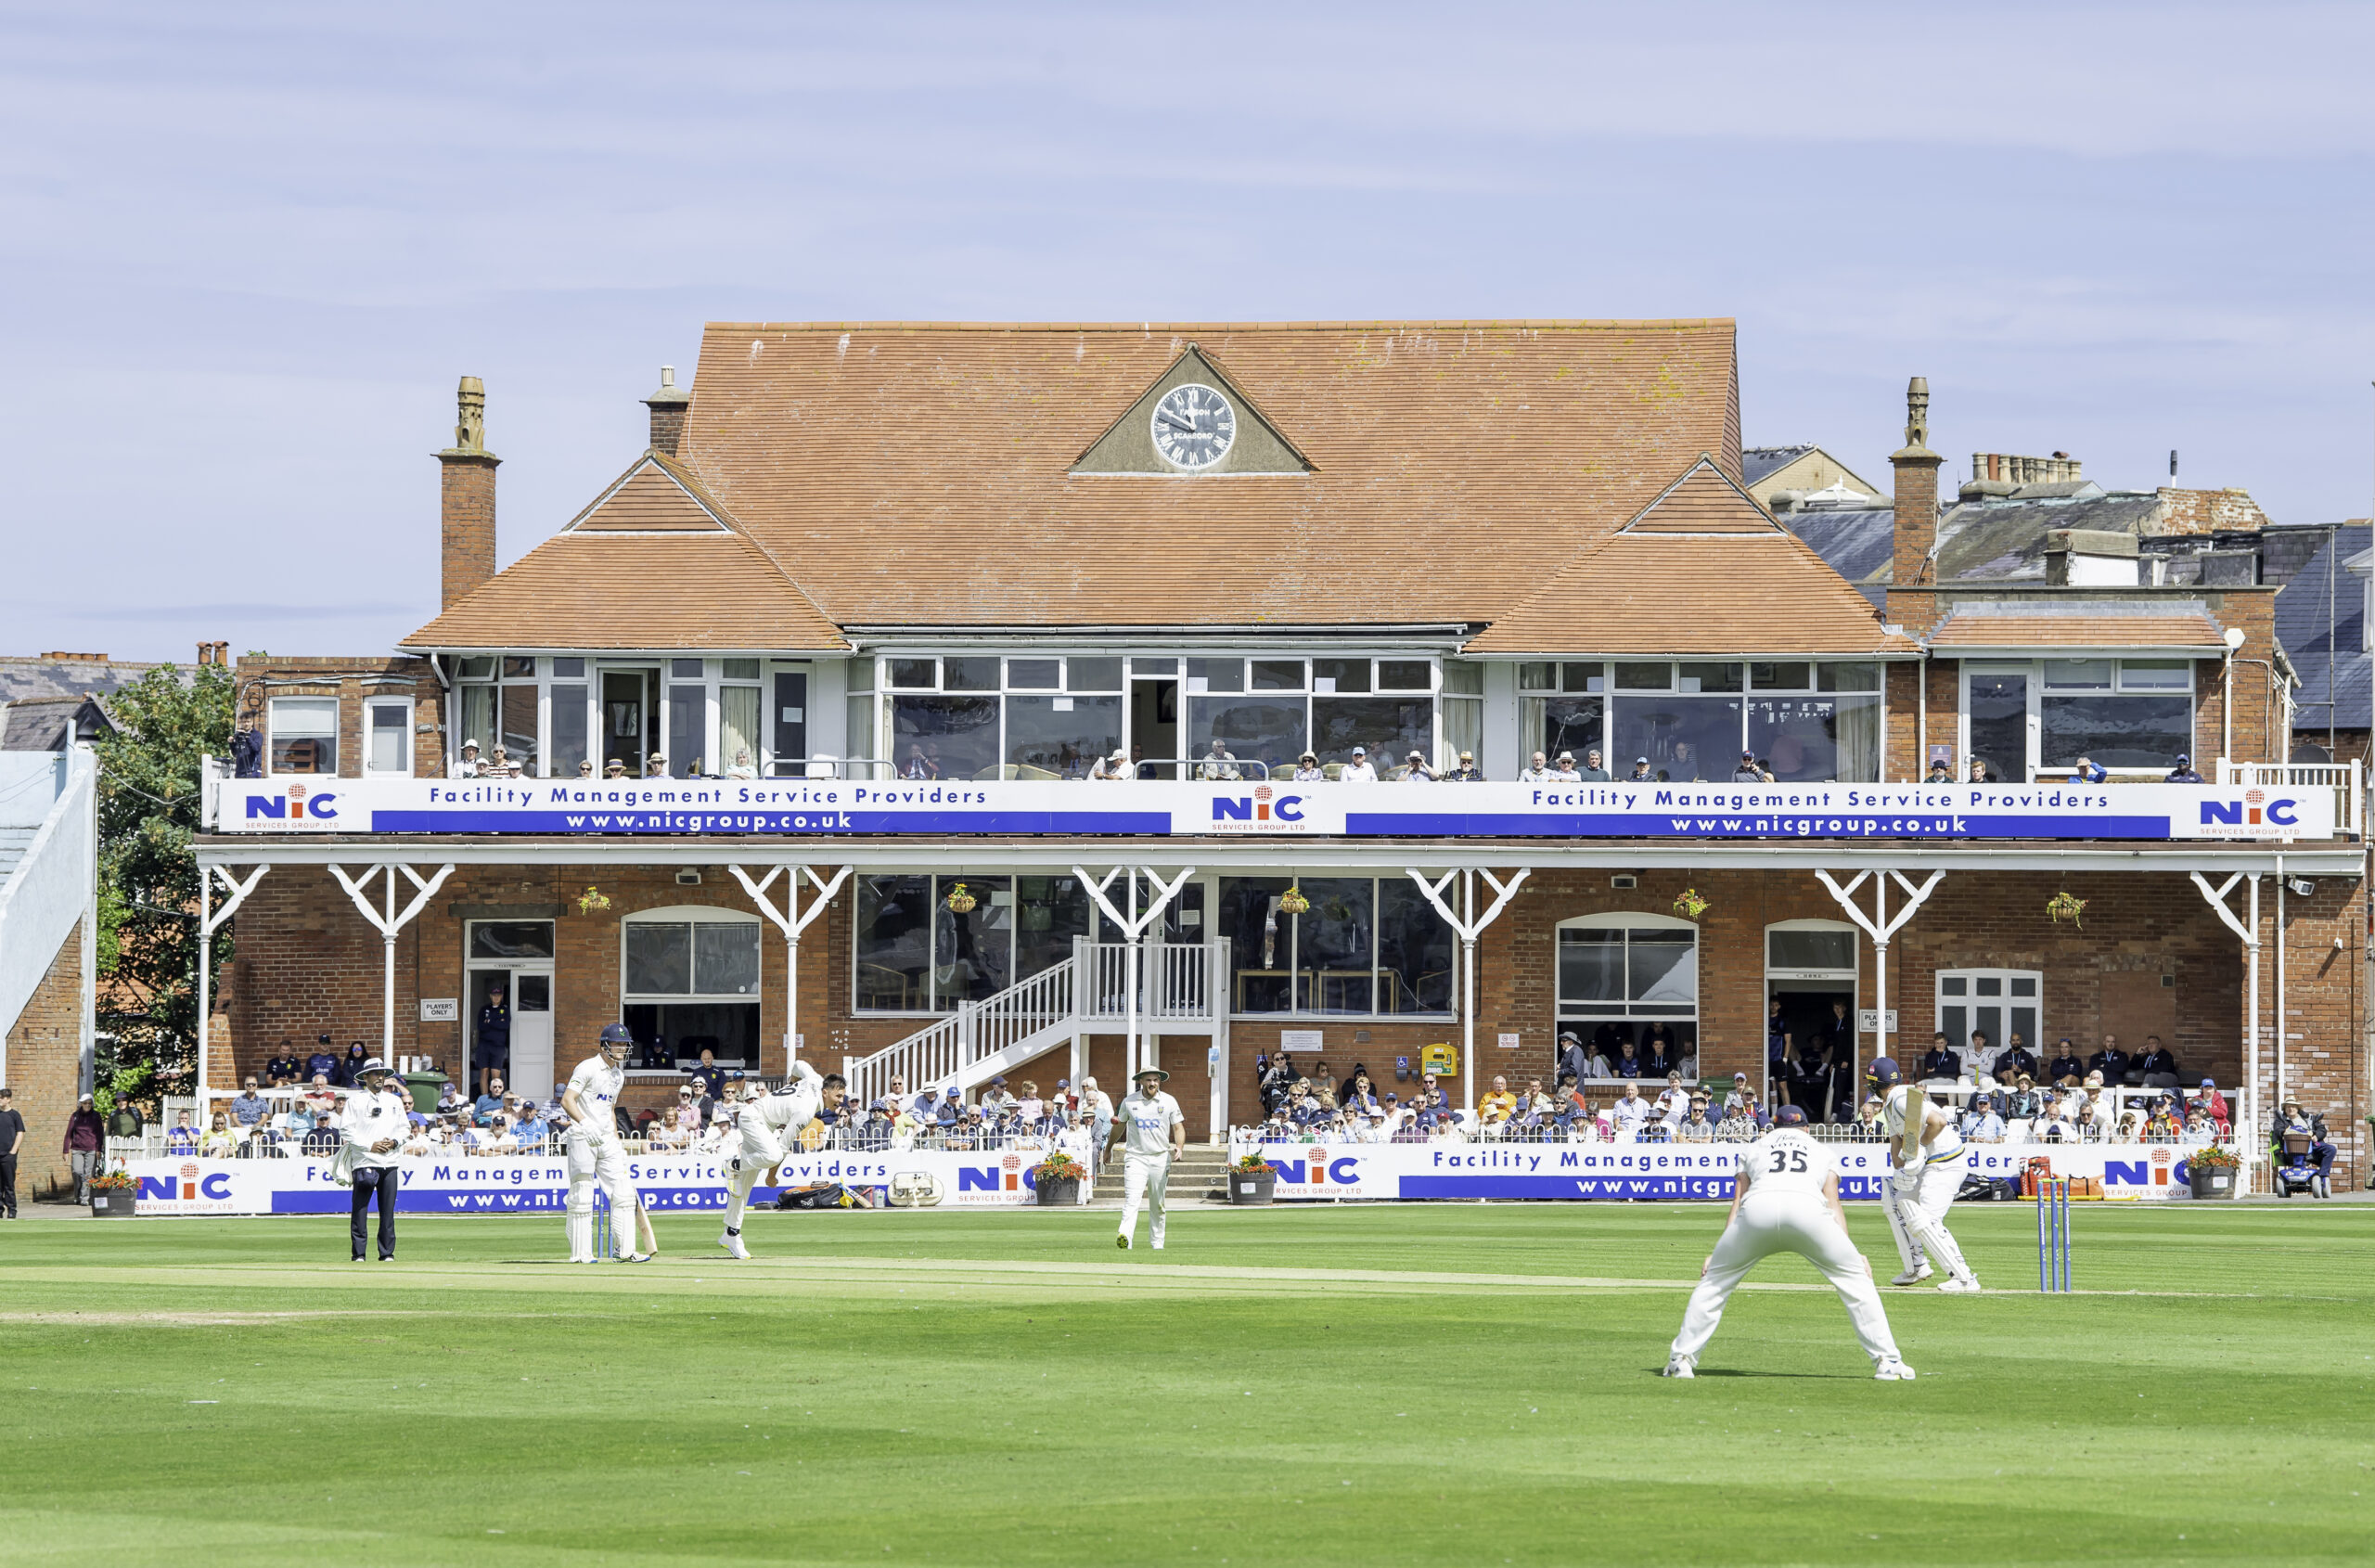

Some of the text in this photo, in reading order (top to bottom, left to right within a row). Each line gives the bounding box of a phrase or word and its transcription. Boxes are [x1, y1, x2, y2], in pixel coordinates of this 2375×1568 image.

[431, 787, 985, 807] Facility Management Service Providers
[1533, 790, 2107, 811] Facility Management Service Providers
[566, 812, 852, 832] www.nicgroup.co.uk
[1671, 816, 1967, 836] www.nicgroup.co.uk
[1433, 1150, 1541, 1172] Facility
[1768, 1150, 1808, 1174] 35
[433, 1165, 563, 1185] Managem
[782, 1160, 886, 1177] oviders
